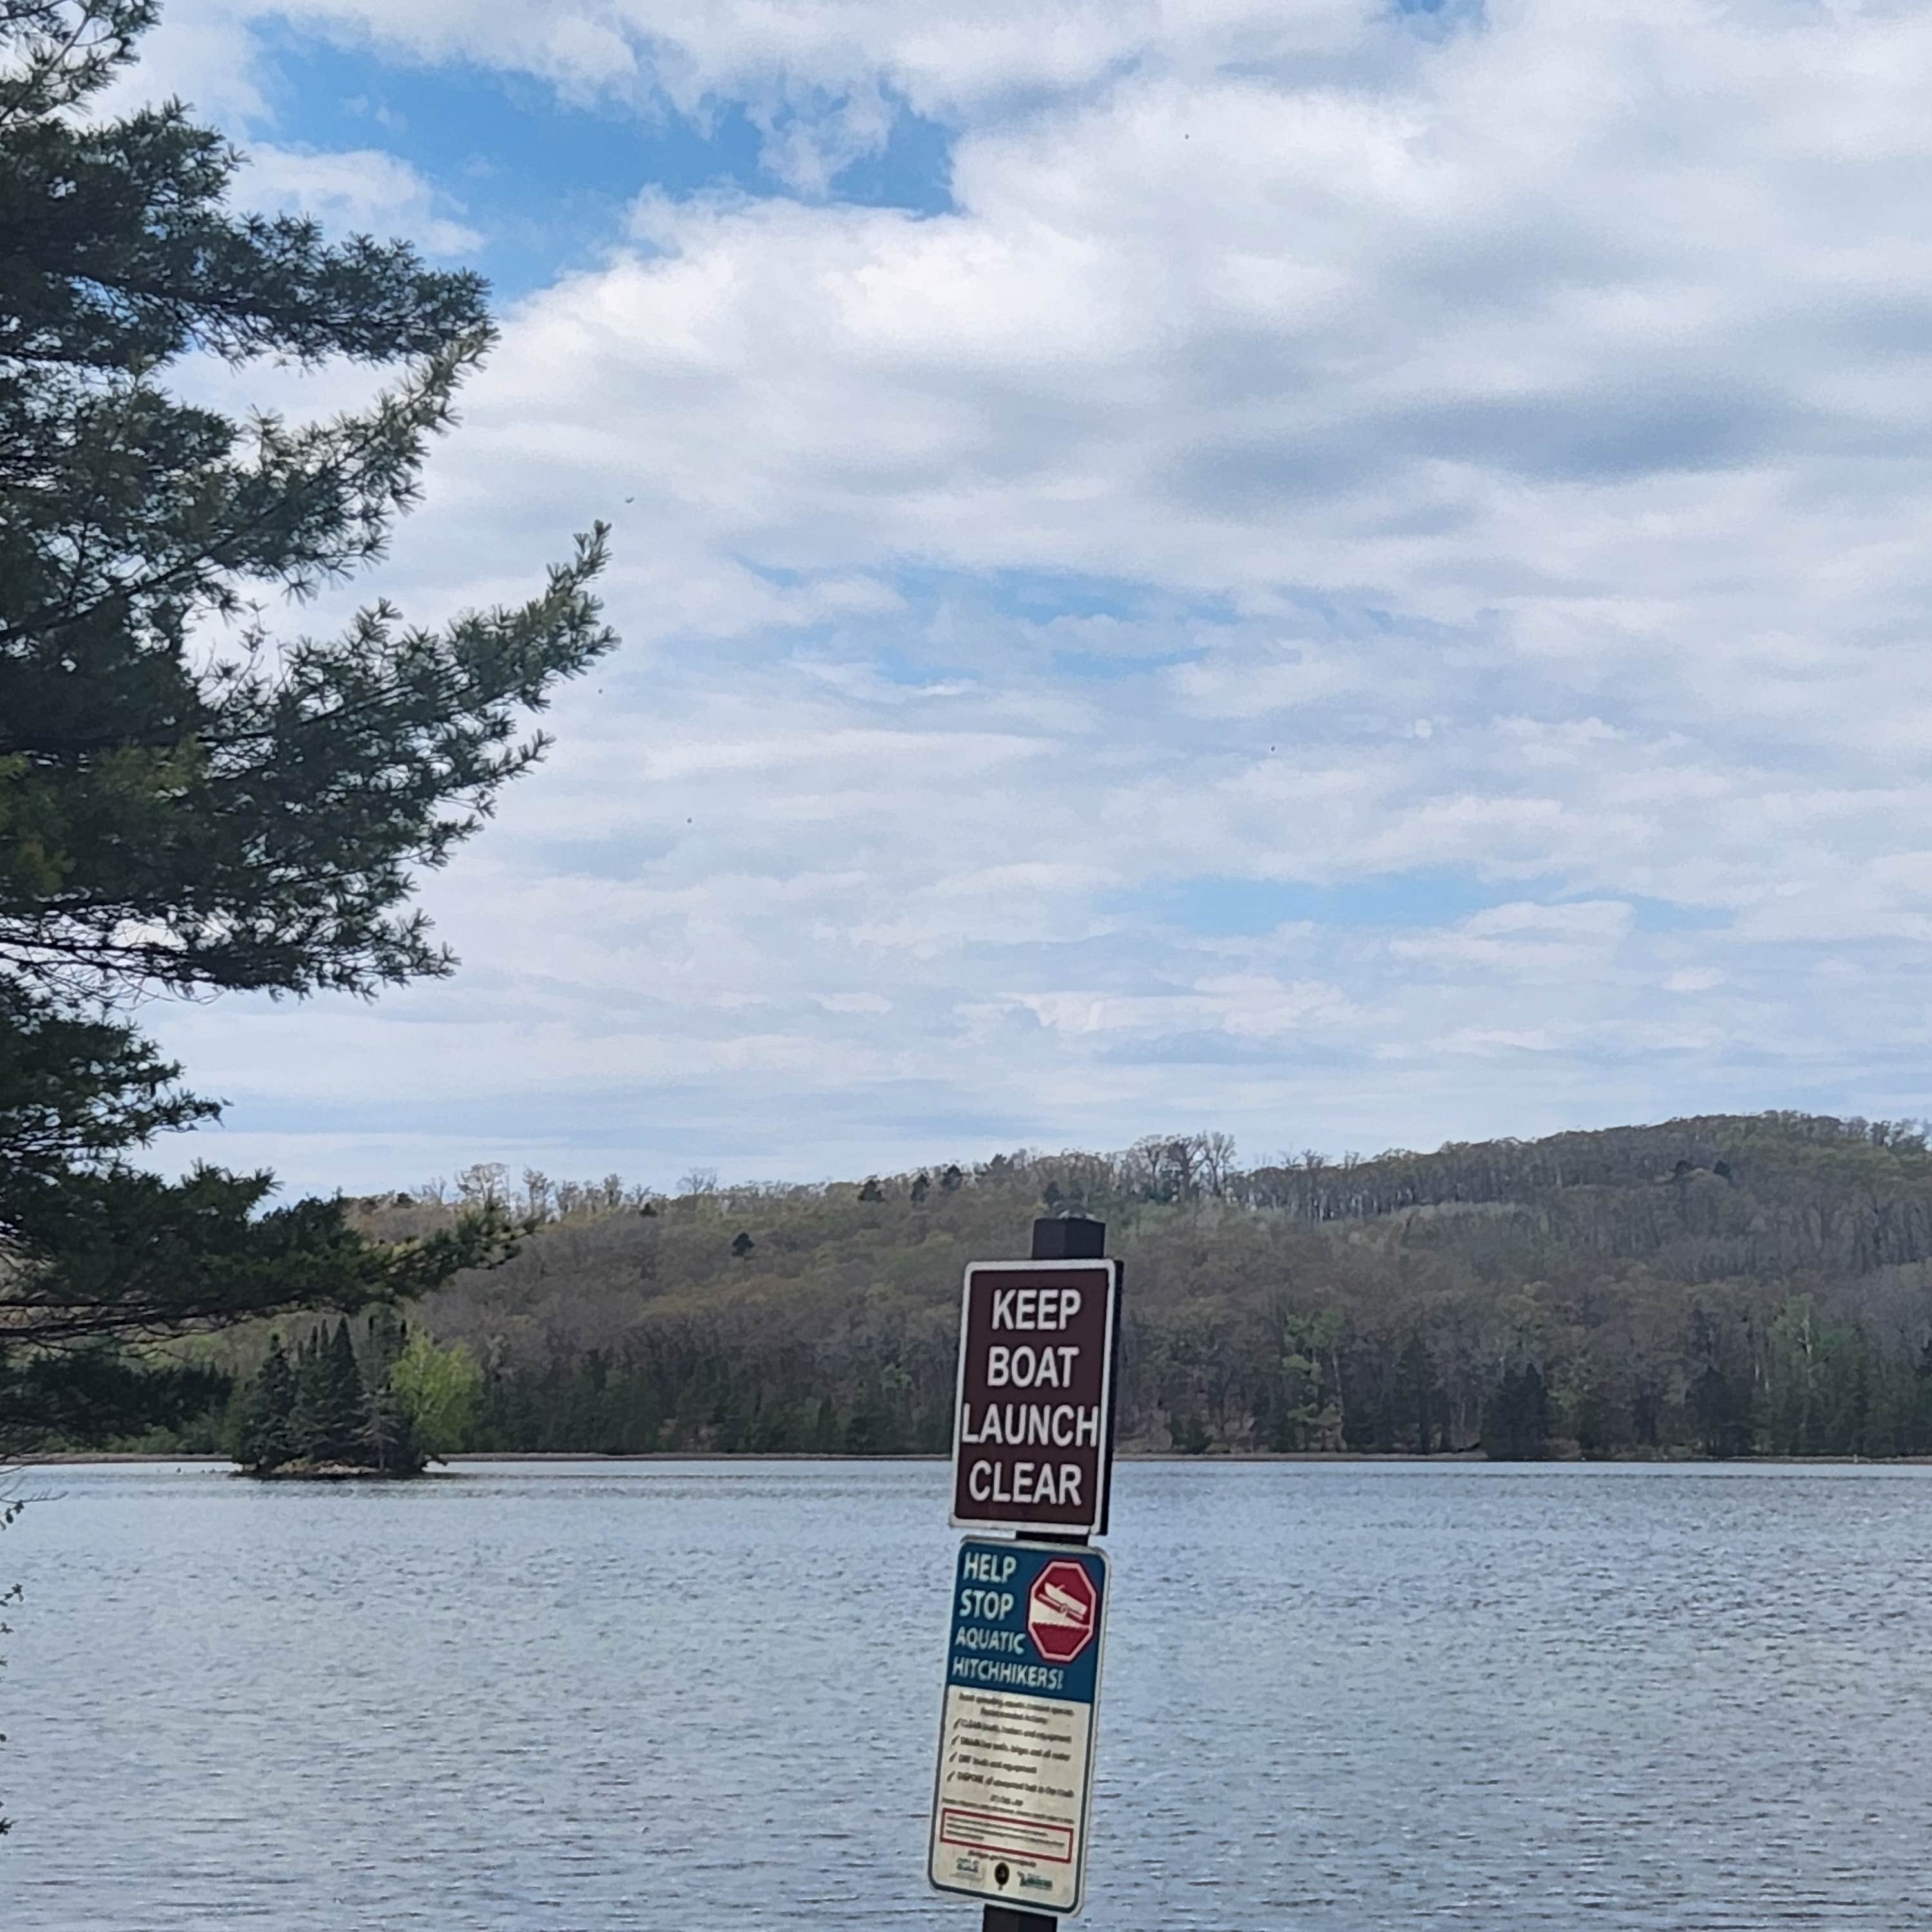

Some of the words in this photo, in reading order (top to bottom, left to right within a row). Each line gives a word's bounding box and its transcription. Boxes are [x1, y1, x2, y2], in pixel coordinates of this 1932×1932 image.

[991, 1288, 1082, 1331] KEEP
[987, 1346, 1079, 1388] BOAT
[961, 1403, 1099, 1447] LAUNCH
[969, 1459, 1083, 1506] CLEAR
[963, 1551, 1017, 1584] HELP
[959, 1589, 1014, 1621] STOP
[955, 1626, 1026, 1654] AQUATIC
[952, 1656, 1065, 1690] HITCHHIKERS!
